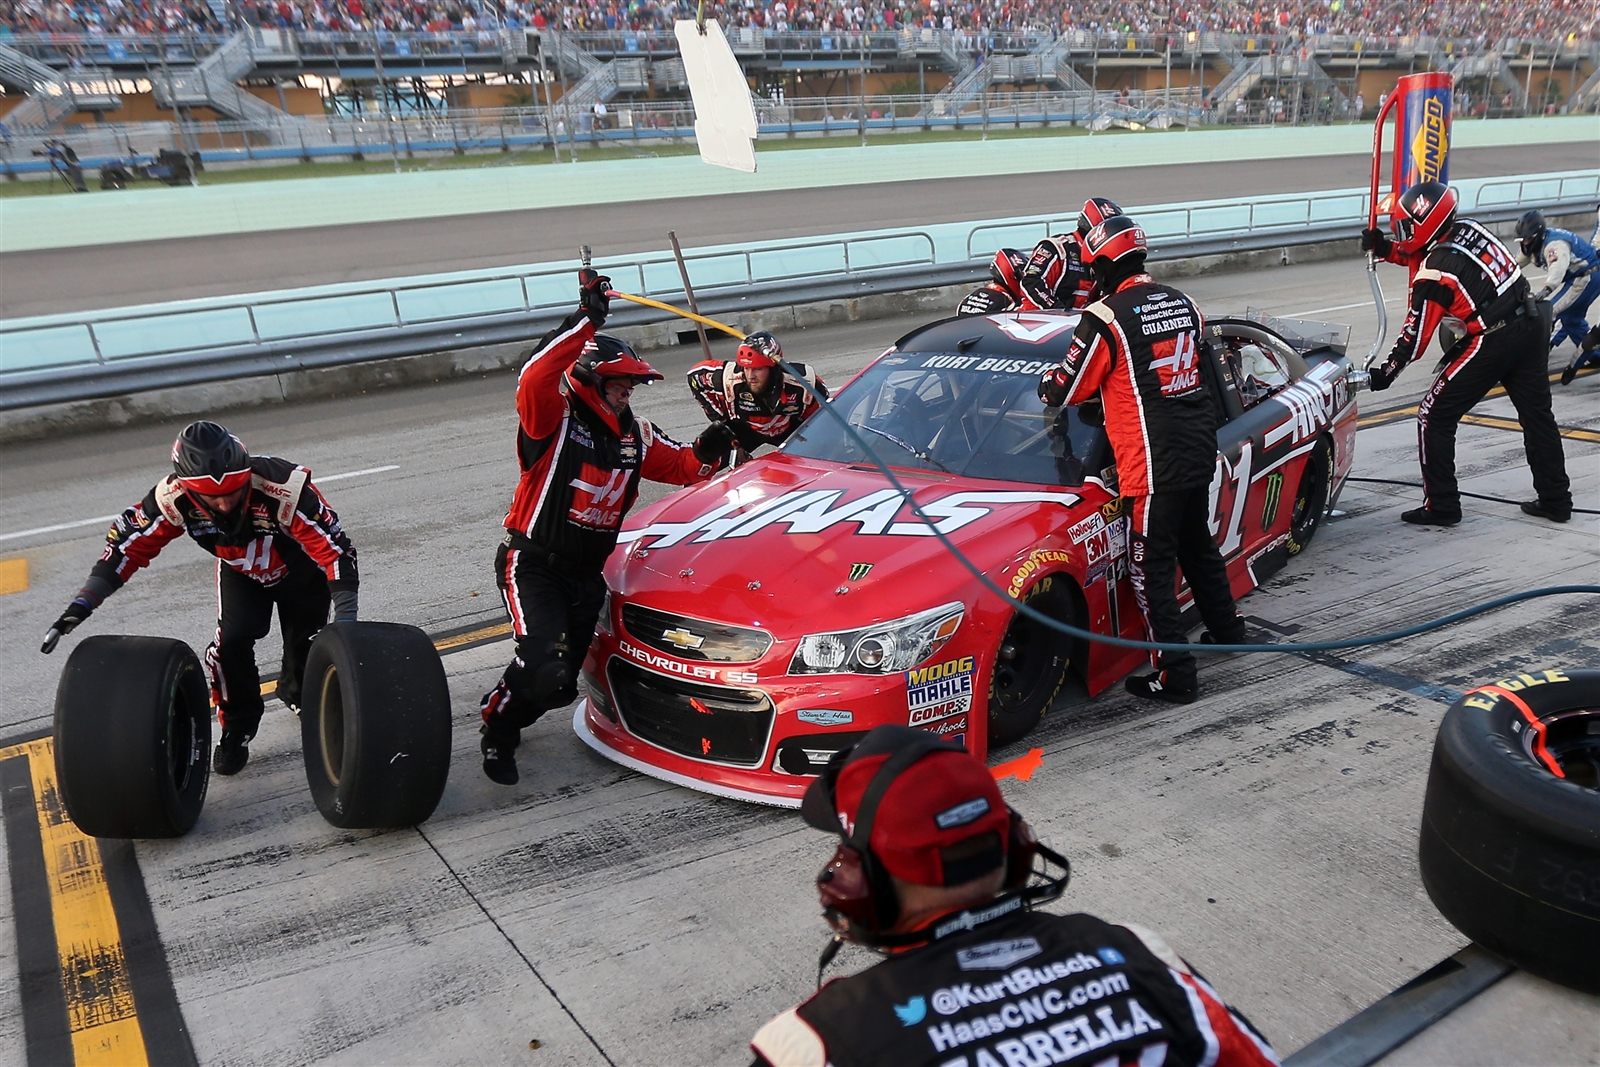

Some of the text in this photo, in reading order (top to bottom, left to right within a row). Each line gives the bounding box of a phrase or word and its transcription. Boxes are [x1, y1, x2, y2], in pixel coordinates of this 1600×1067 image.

[1380, 198, 1392, 213] 4
[1134, 230, 1143, 238] 41
[1140, 307, 1189, 323] HaasCNC.com
[1141, 299, 1183, 313] @KurtBusch
[1141, 316, 1193, 336] GUARNERI
[920, 355, 980, 370] KURT
[975, 357, 1062, 376] BUSCH
[1160, 369, 1199, 393] HAAS
[1433, 379, 1446, 395] CNC
[1265, 360, 1340, 449] HAAS
[617, 488, 1081, 549] HAAS
[1108, 518, 1125, 538] Mob
[1068, 521, 1092, 541] Holley
[1086, 529, 1109, 562] 3M
[1133, 541, 1145, 562] CNC
[1007, 549, 1070, 599] GOODYEAR
[619, 640, 758, 684] CHEVROLET SS
[908, 656, 974, 687] MOOG
[909, 676, 971, 706] MAHLE
[912, 701, 956, 722] COMP
[970, 897, 1022, 925] ELECTRONICS
[931, 952, 1102, 1016] @KurtBusch
[927, 972, 1130, 1053] HaasCNC.com
